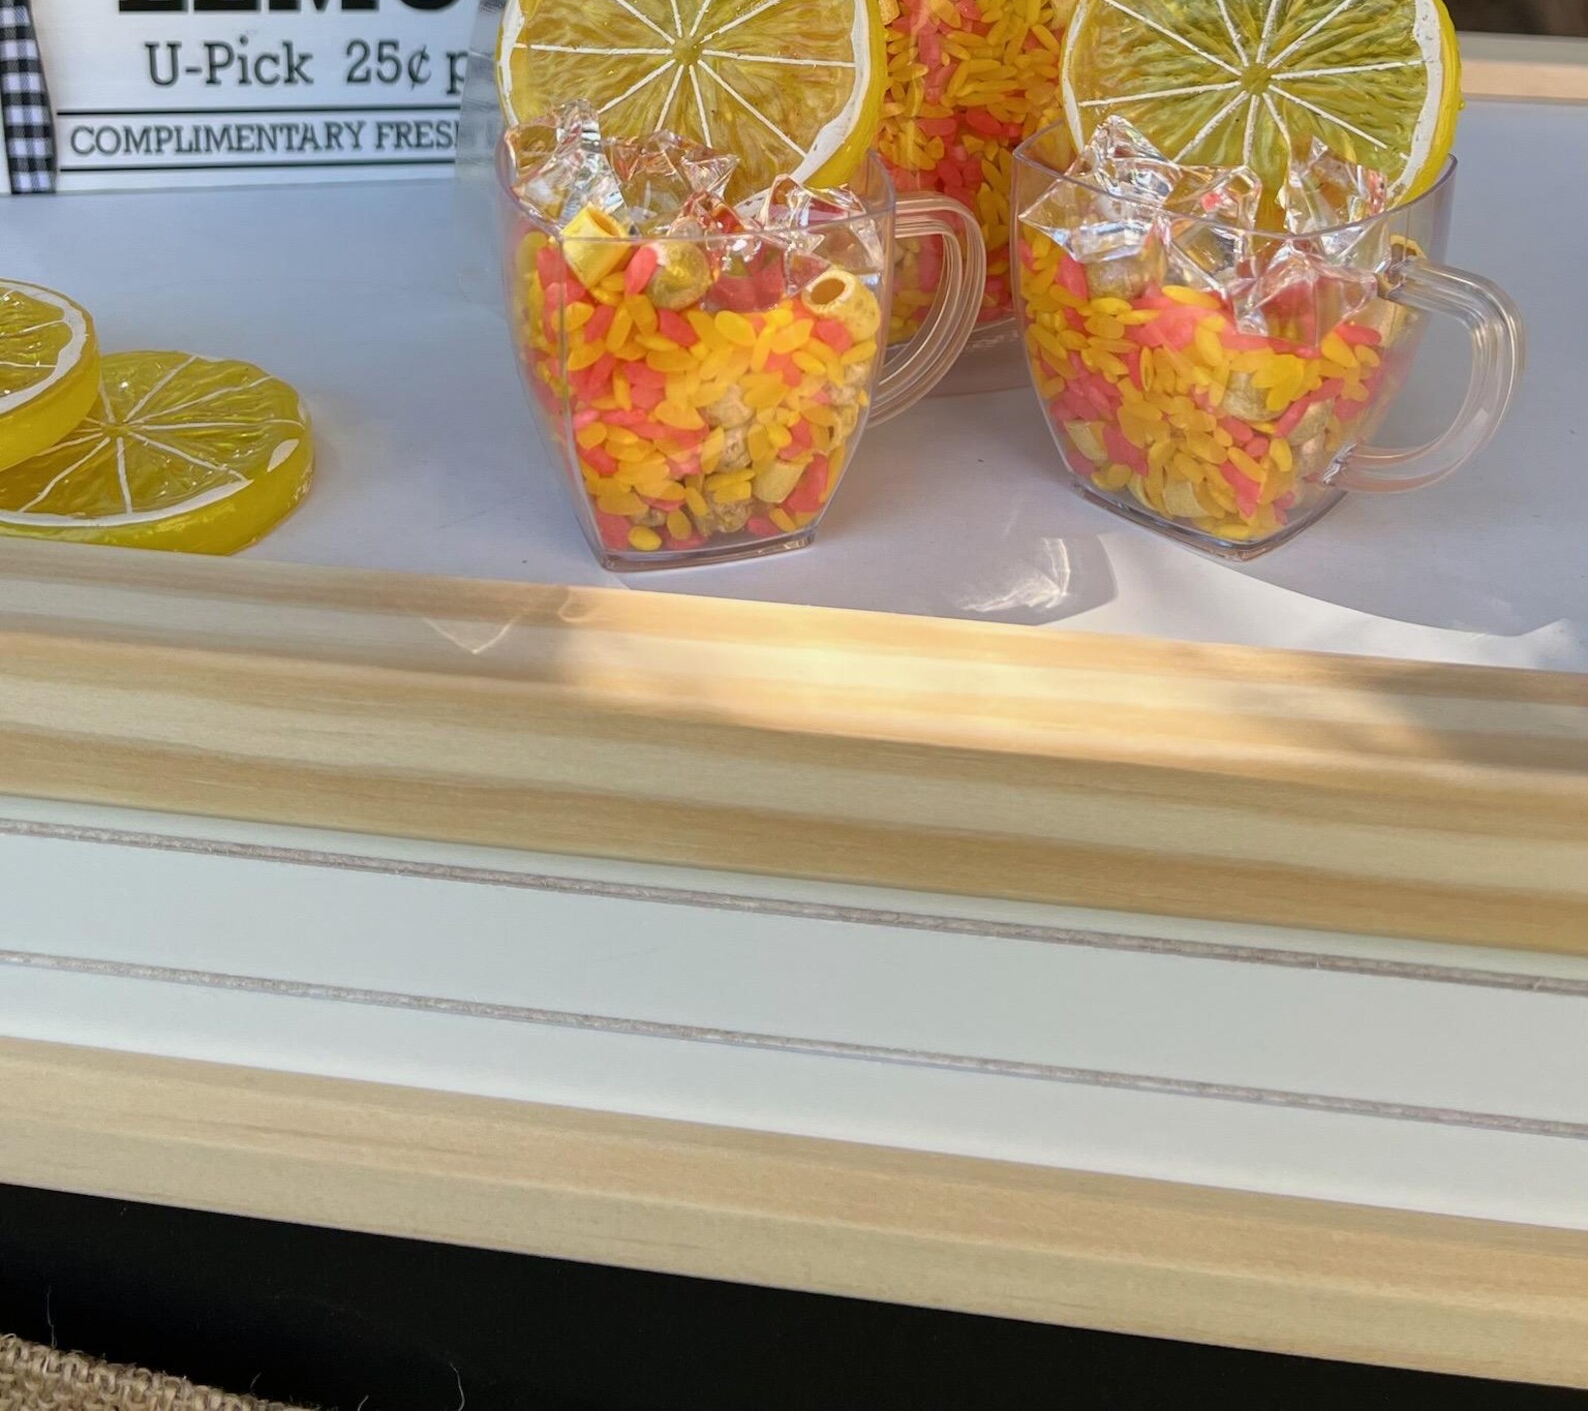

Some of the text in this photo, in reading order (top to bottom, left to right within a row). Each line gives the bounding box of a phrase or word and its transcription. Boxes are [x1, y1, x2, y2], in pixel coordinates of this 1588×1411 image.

[144, 35, 314, 87] U-Pick
[345, 40, 433, 90] 25¢
[69, 118, 459, 157] COMPLIMENTARY FRES
